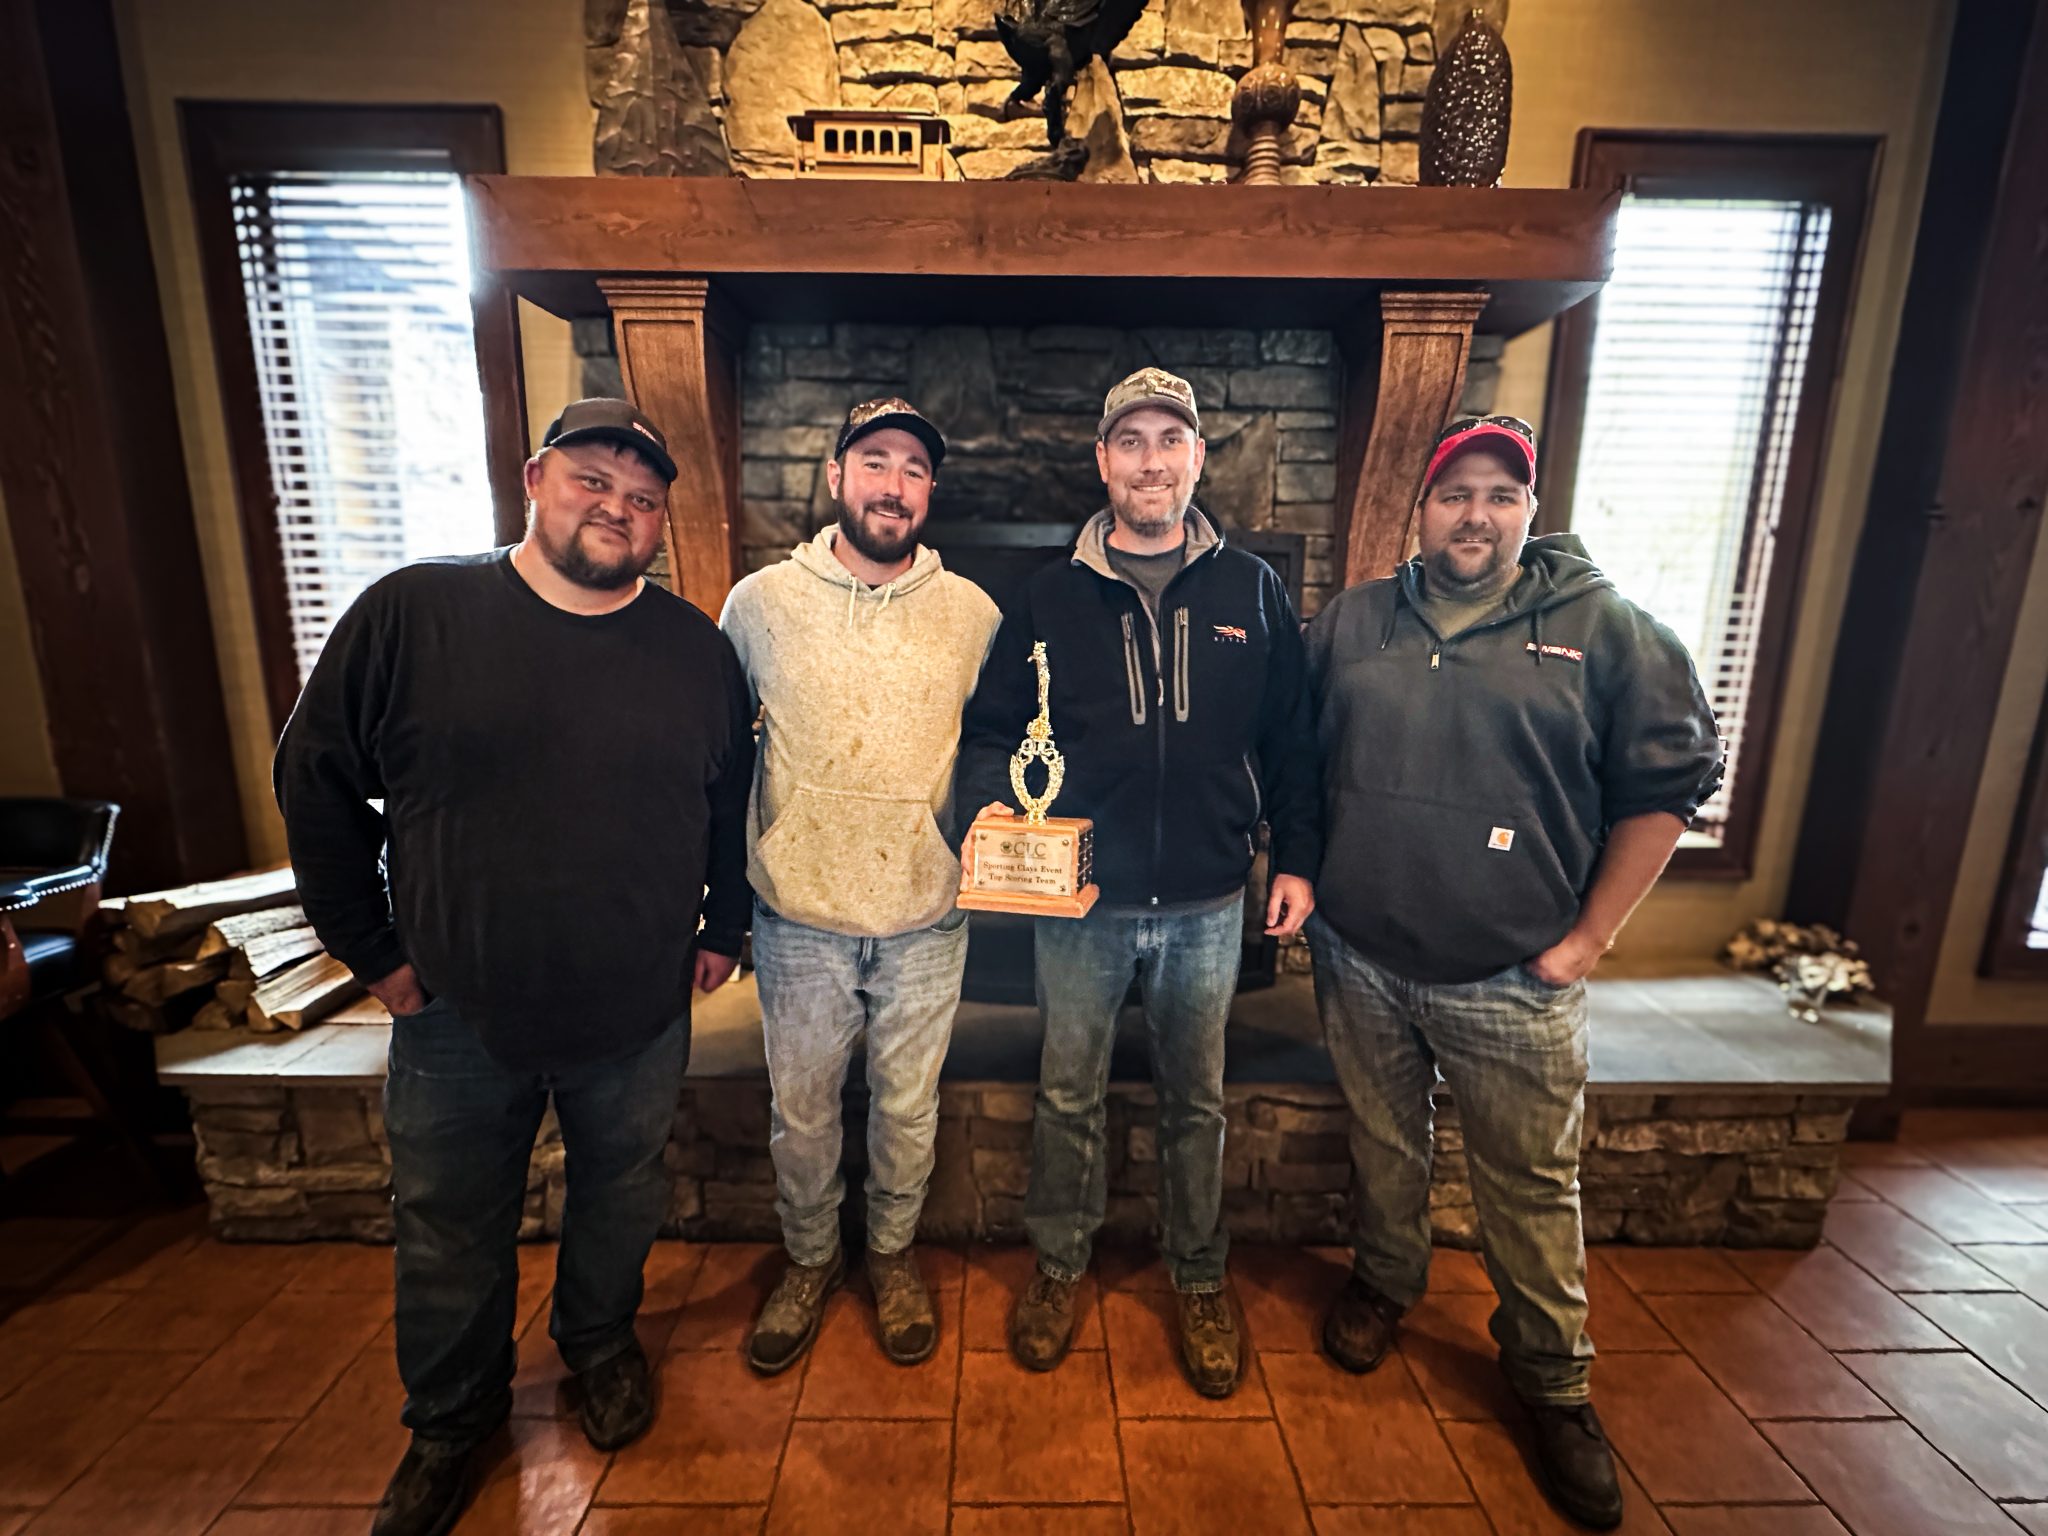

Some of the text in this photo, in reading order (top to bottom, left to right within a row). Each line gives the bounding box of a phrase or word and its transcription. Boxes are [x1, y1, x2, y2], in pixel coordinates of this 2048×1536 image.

[1014, 841, 1046, 857] CLC
[983, 861, 1062, 874] Sporting Clays Event
[989, 873, 1056, 885] Top Scoring Team
